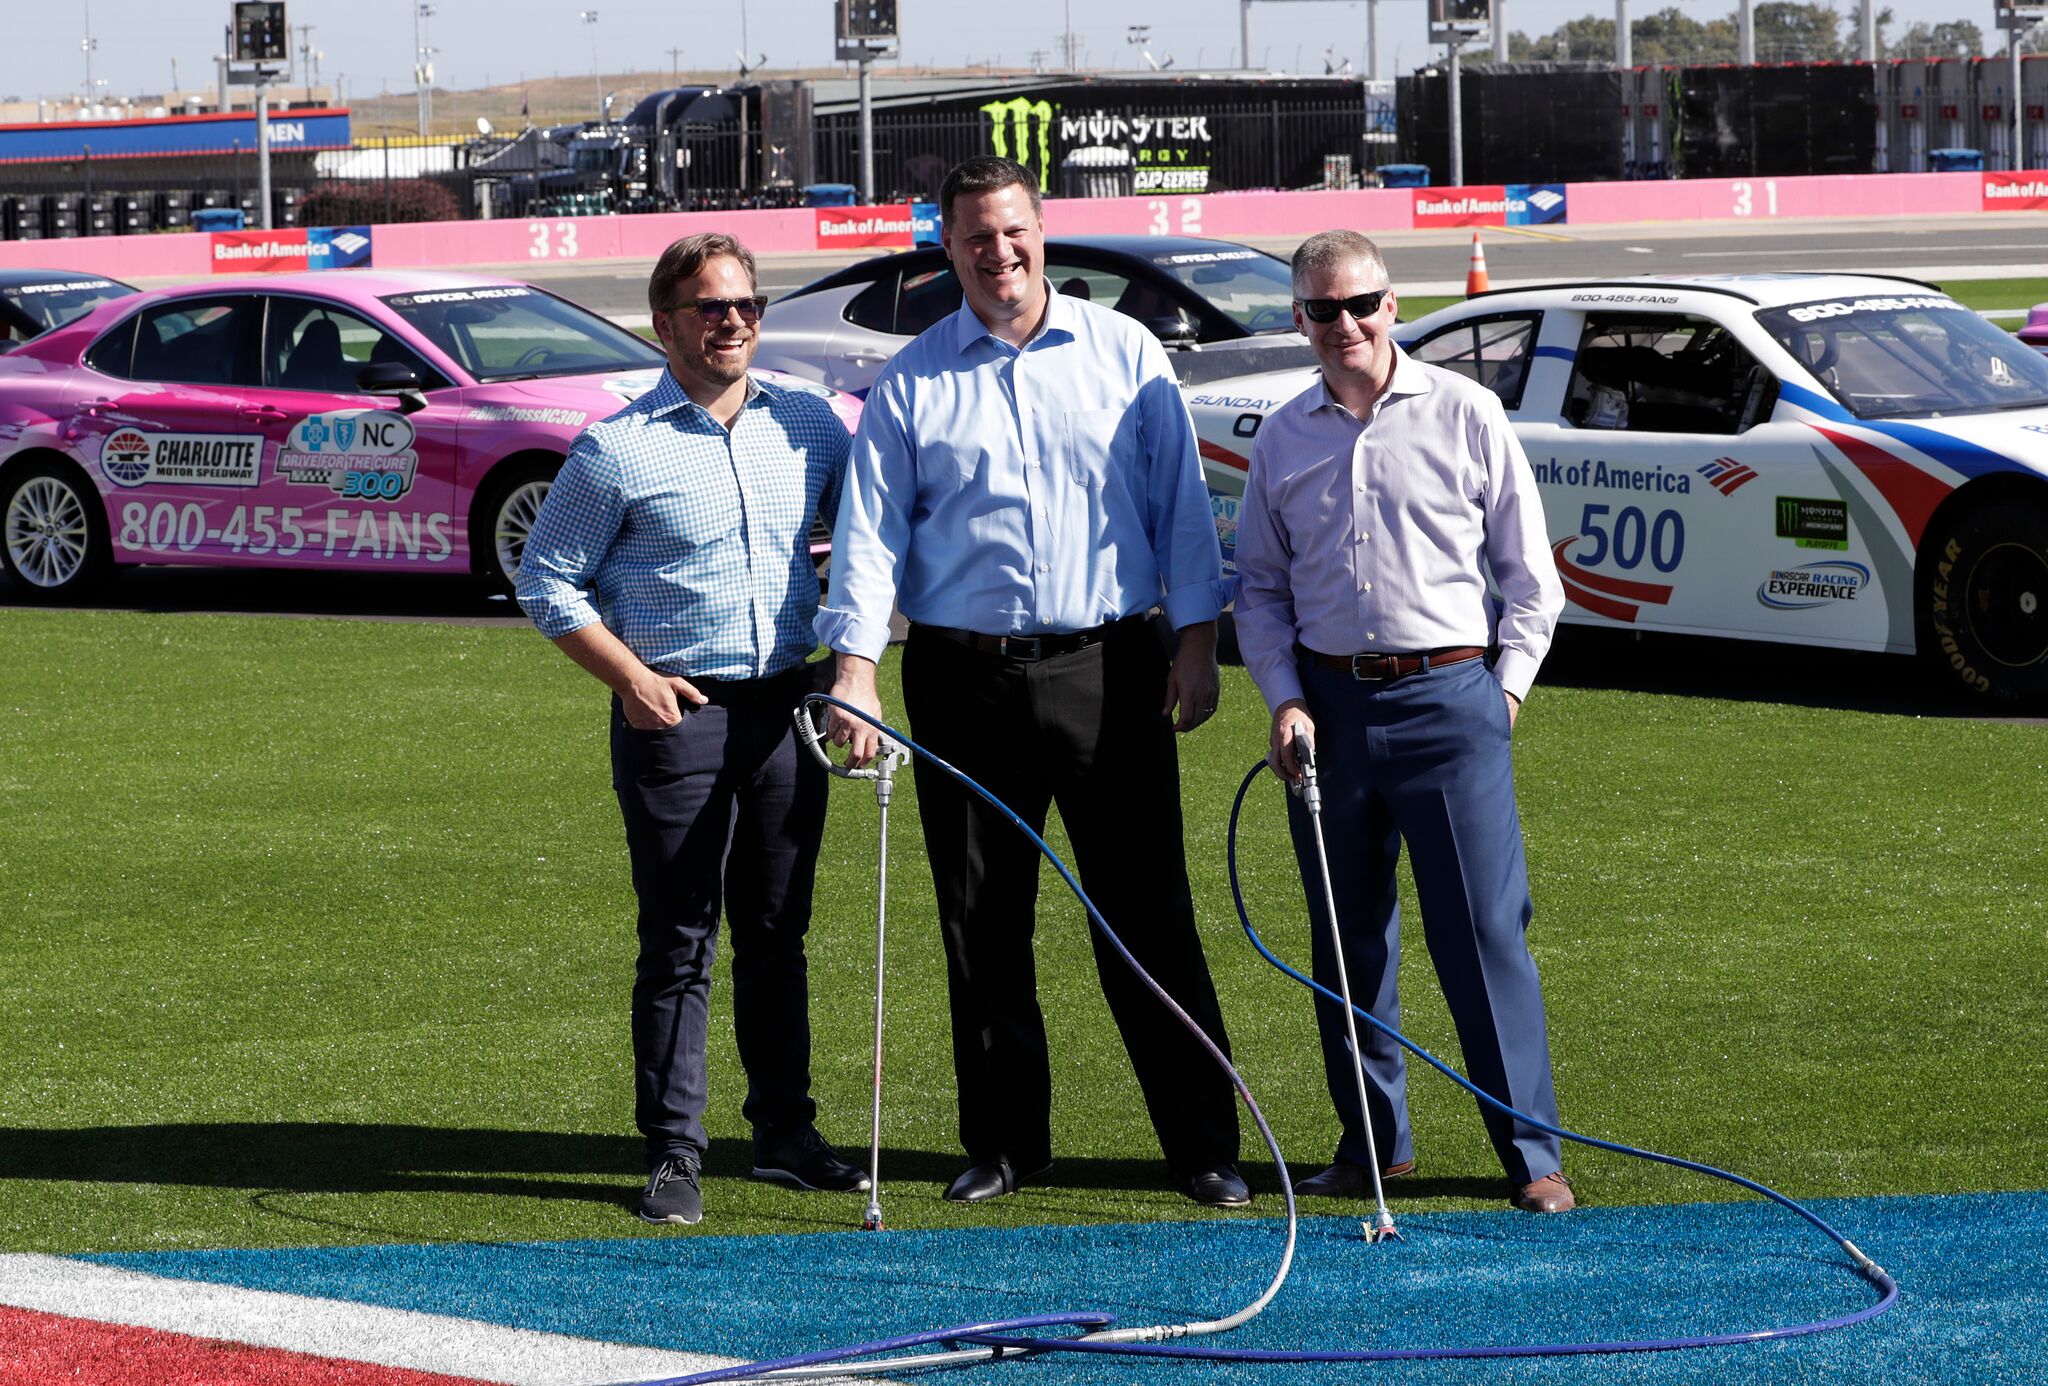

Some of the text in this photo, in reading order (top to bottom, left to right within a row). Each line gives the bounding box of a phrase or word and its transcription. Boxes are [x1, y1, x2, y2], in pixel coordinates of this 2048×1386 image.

[1060, 109, 1212, 146] MONSTER
[1985, 182, 2020, 198] Bank
[2020, 181, 2035, 198] of
[1416, 197, 1527, 215] Bank of America
[820, 216, 934, 236] Bank of America
[214, 239, 330, 260] Bank of America
[1571, 294, 1679, 304] 800-455-FANS
[1190, 395, 1280, 410] SUNDAY
[466, 405, 588, 427] #BlueCrossNC300
[362, 422, 396, 448] NC
[155, 440, 255, 467] CHARLOTTE
[282, 454, 408, 471] DRIVE FOR THE CURE
[156, 467, 253, 479] MOTOR SPEEDWAY
[1530, 457, 1690, 494] nk of America
[342, 471, 403, 499] 300
[1801, 506, 1844, 517] MONSTER
[120, 501, 453, 562] 800-455-FANS
[1575, 503, 1685, 573] 500
[1775, 571, 1858, 586] NASCAR RACING
[1769, 580, 1857, 600] EXPERIENCE
[1933, 537, 1990, 692] GOODYEAR
